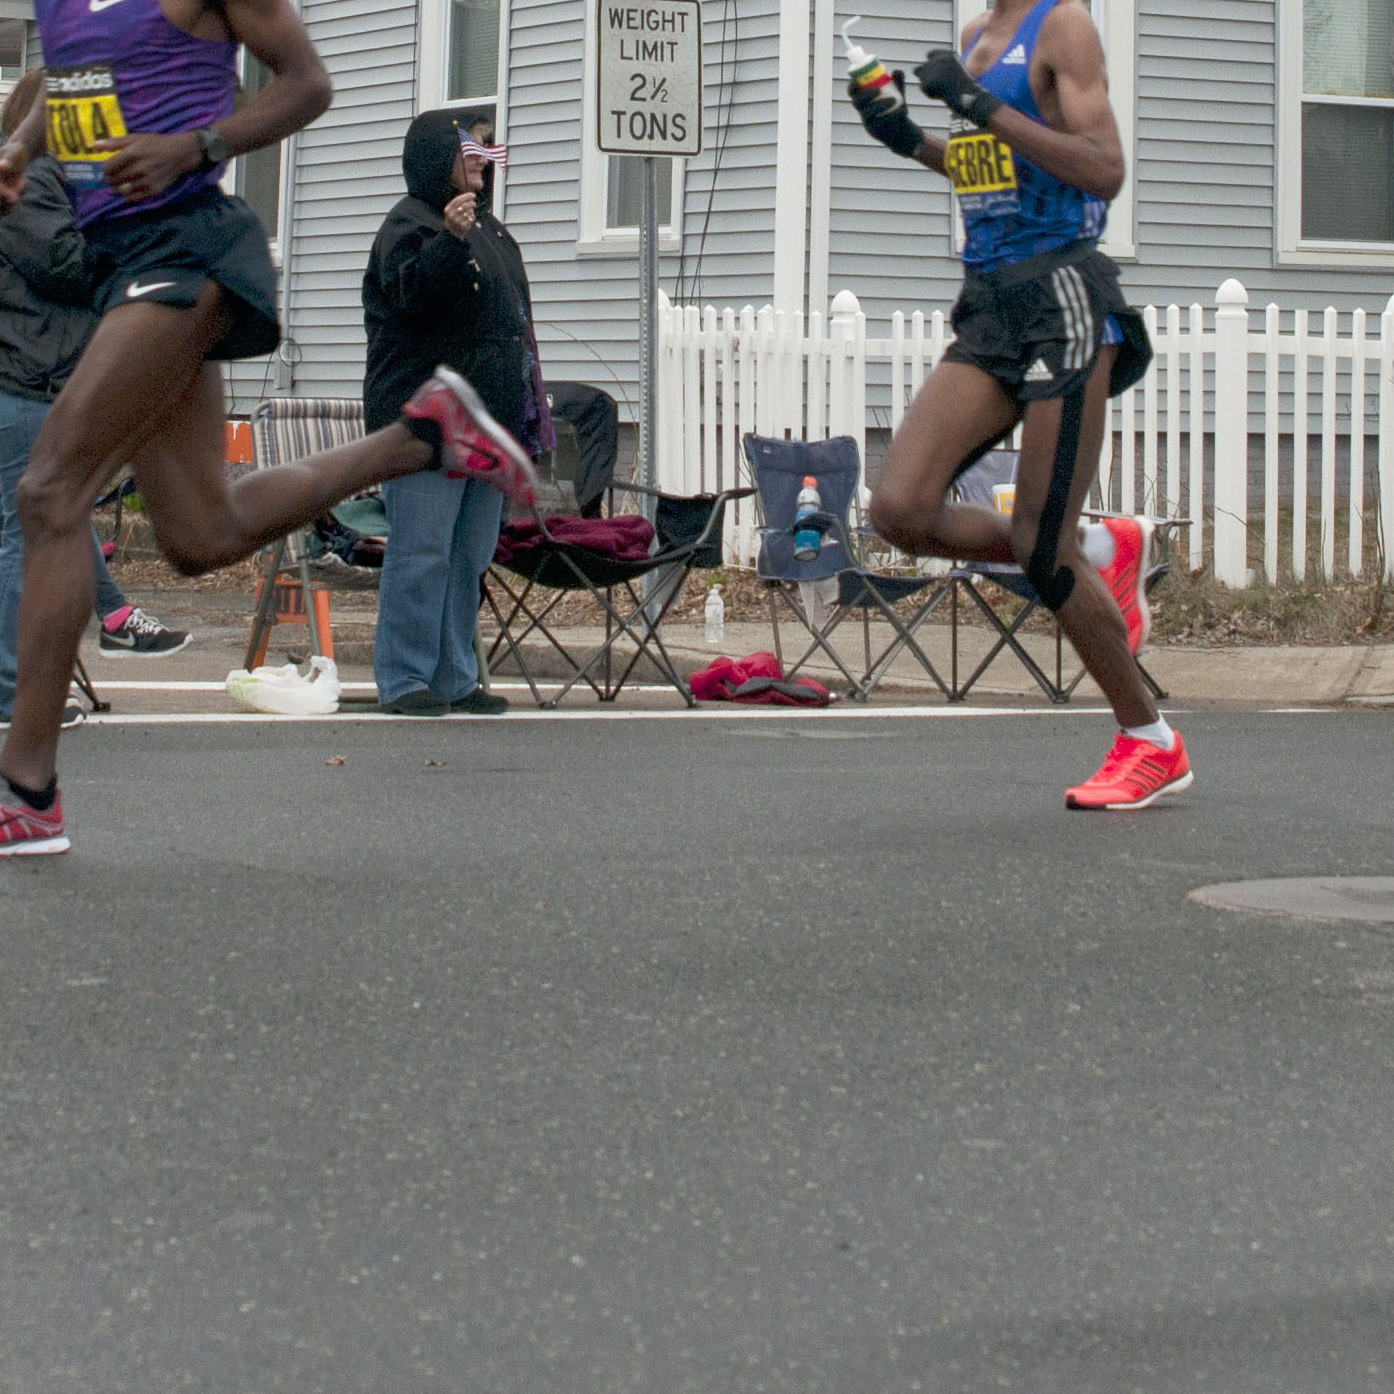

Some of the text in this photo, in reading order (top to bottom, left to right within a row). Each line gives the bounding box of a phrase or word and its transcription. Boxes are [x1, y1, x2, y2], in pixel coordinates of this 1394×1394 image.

[609, 7, 689, 33] WEIGHT
[620, 38, 678, 62] LIMIT
[610, 110, 687, 142] TONS
